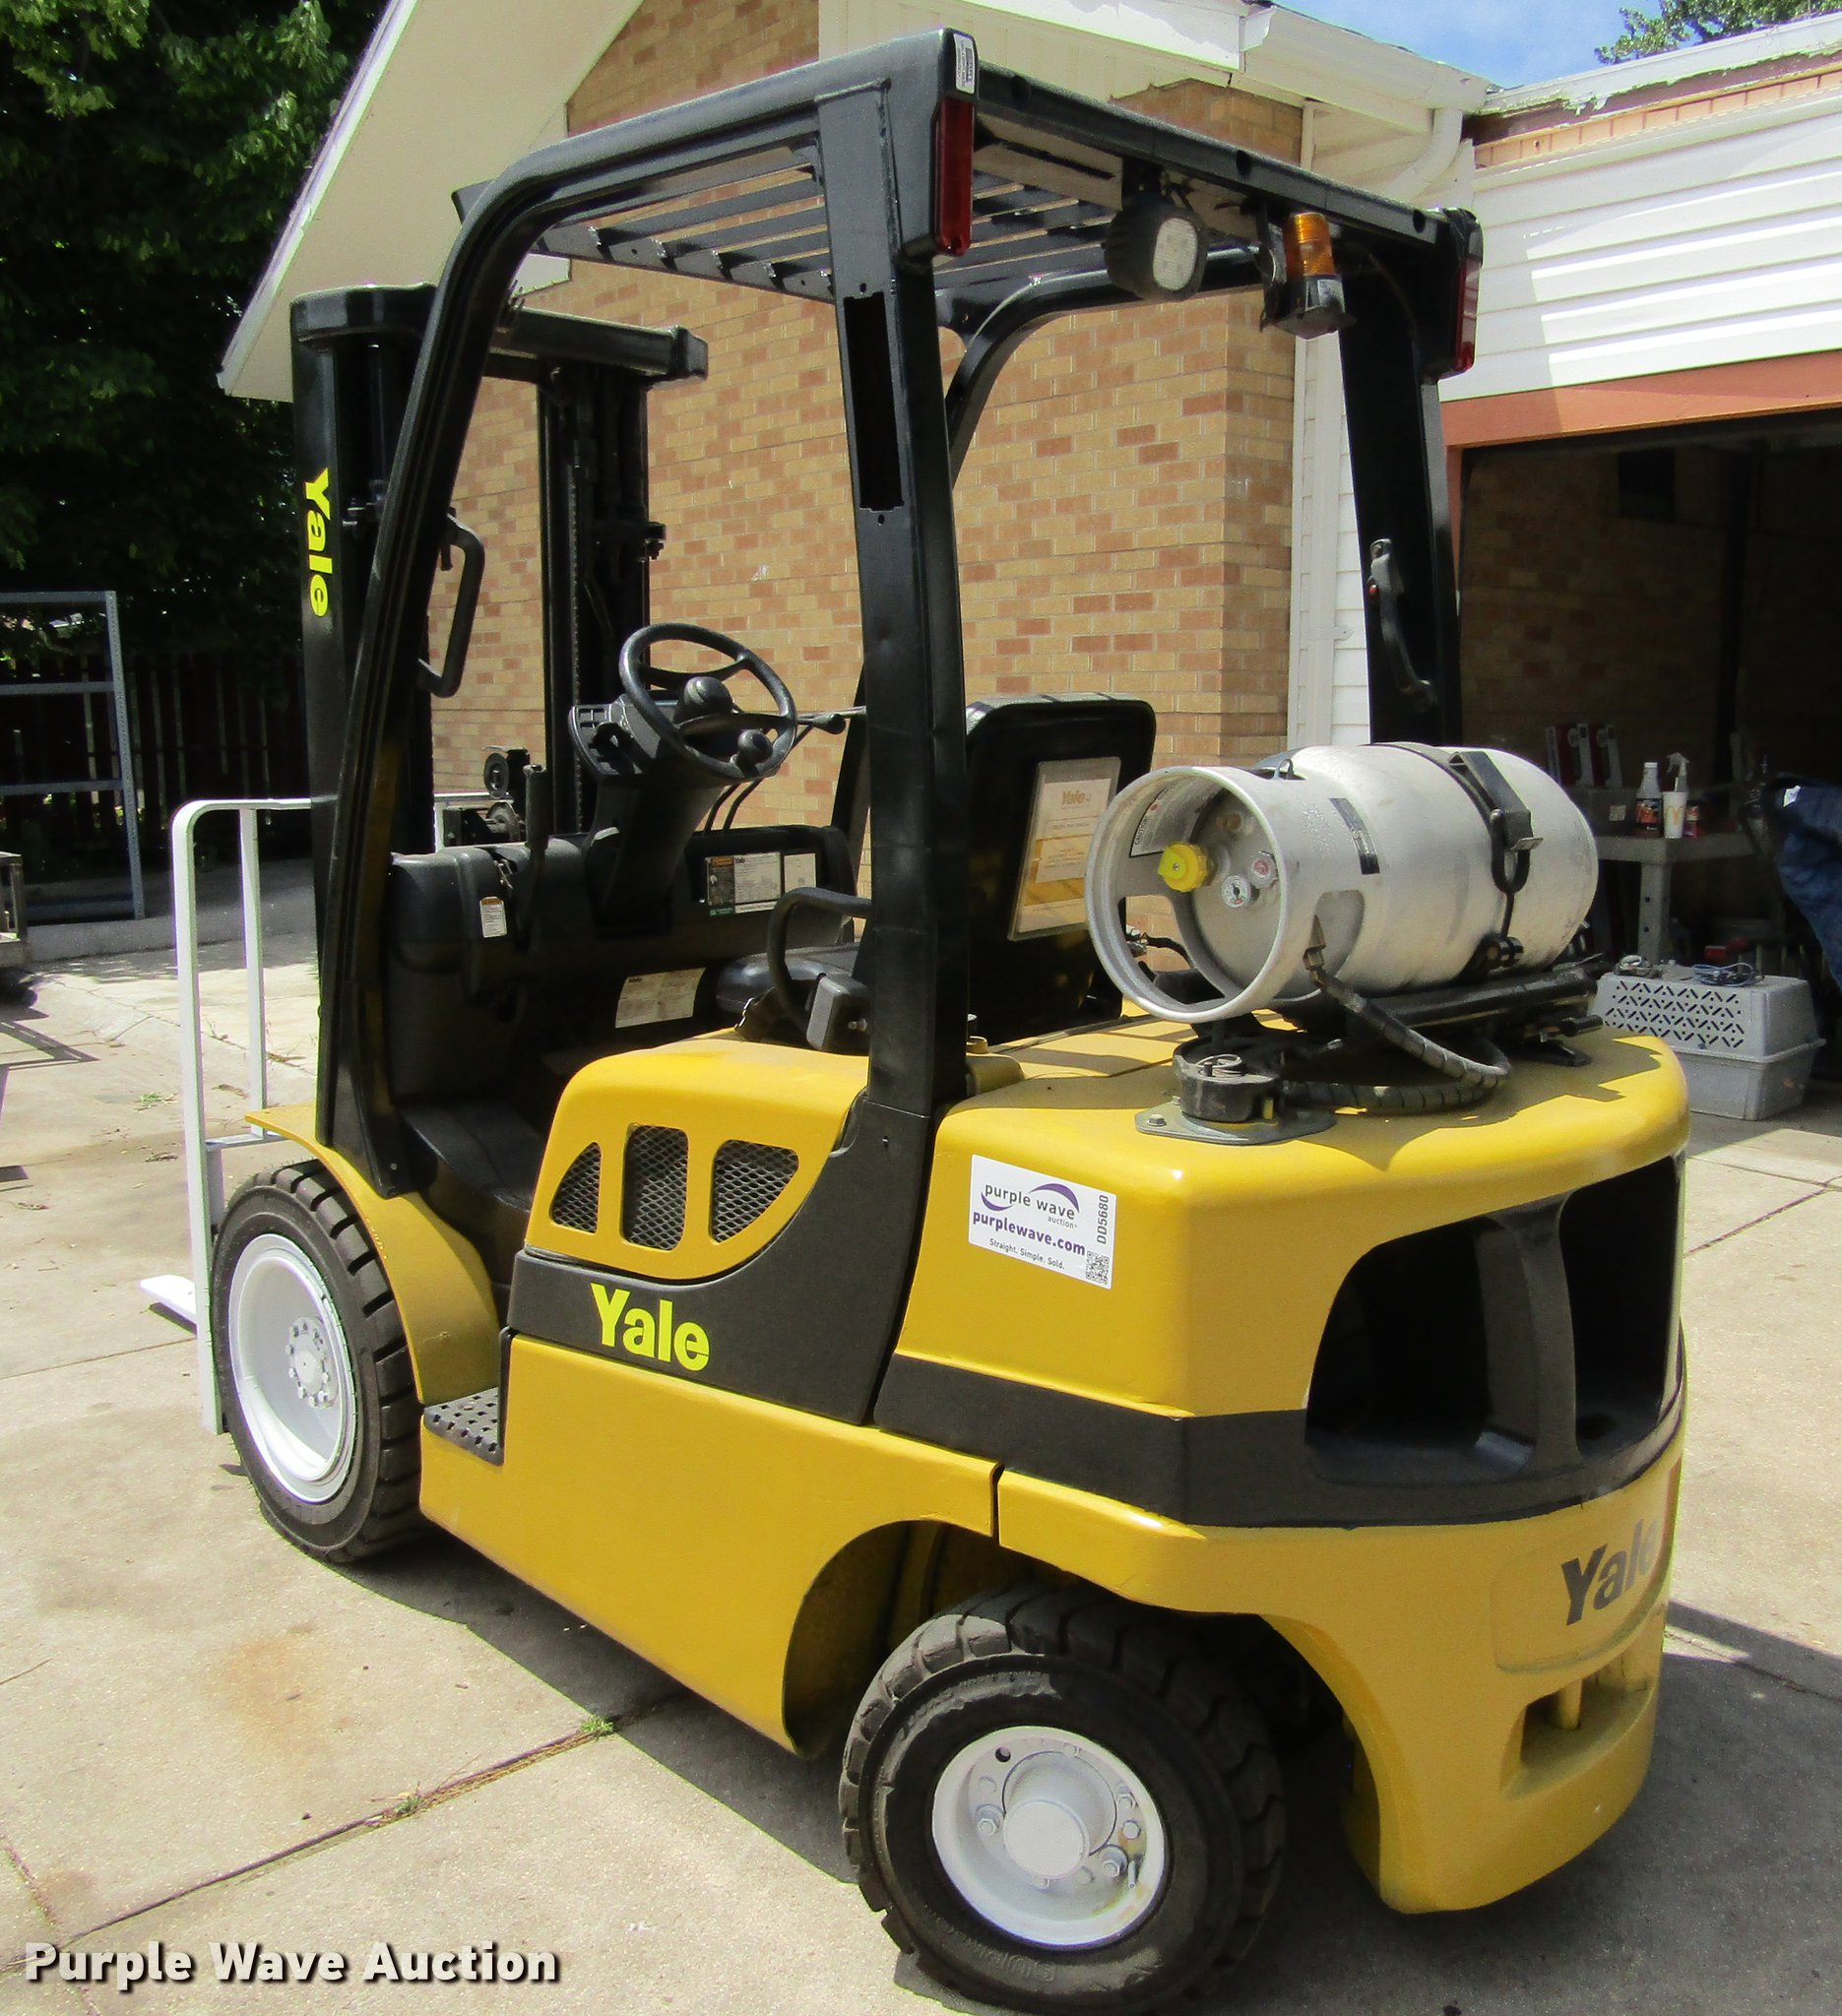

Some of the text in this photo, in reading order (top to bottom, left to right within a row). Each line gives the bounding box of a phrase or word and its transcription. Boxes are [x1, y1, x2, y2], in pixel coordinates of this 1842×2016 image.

[305, 467, 333, 617] Yale
[1061, 789, 1086, 805] Yale
[985, 1183, 1075, 1220] purple wave
[1047, 1216, 1075, 1229] auction
[1096, 1194, 1110, 1244] DD5680
[973, 1211, 1085, 1256] purplewave.com
[989, 1238, 1065, 1270] Straight. Simple. Sold.
[591, 1283, 710, 1371] Yale
[1561, 1517, 1659, 1625] Yale
